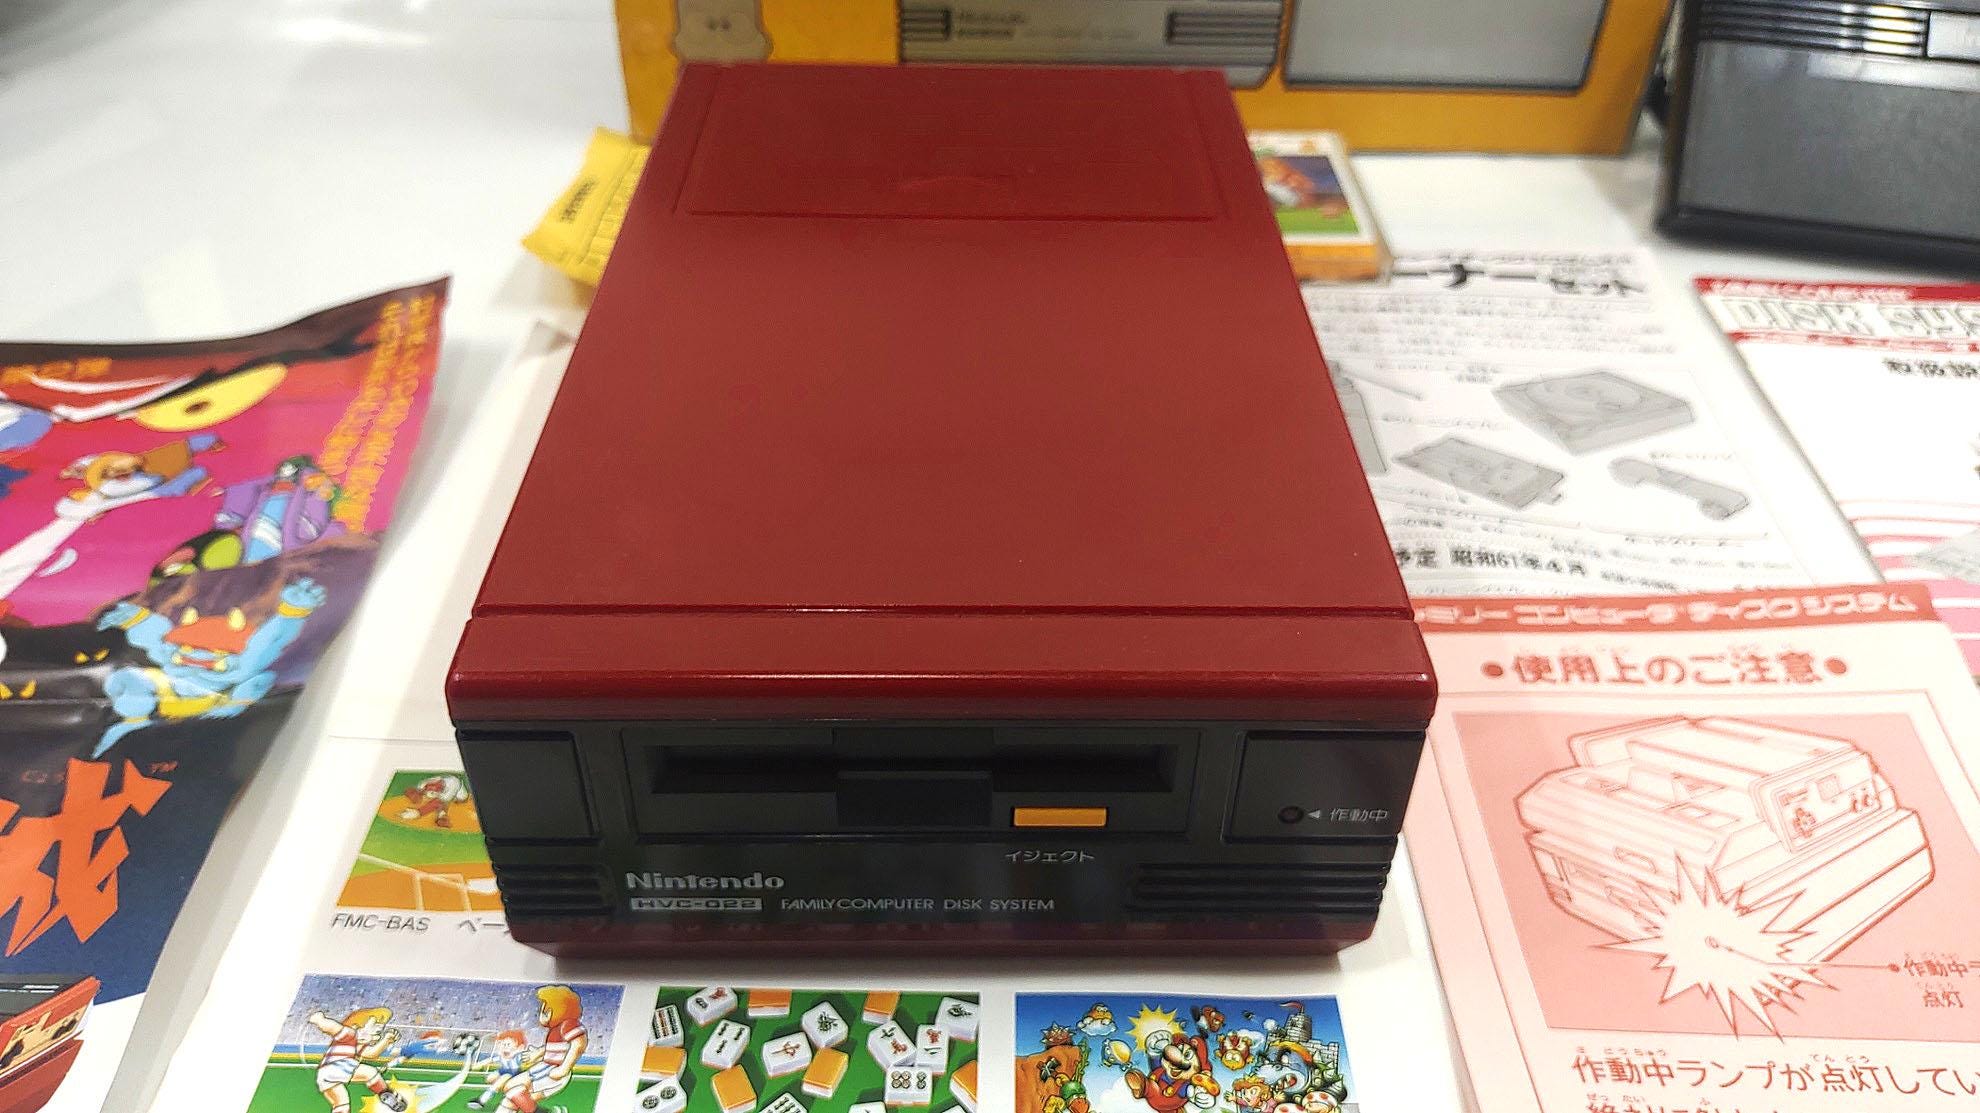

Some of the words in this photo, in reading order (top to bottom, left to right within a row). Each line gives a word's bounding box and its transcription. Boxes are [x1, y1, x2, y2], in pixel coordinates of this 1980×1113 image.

[1513, 652, 1821, 684] 使用上のご注意
[1330, 808, 1388, 822] 作動中
[1005, 850, 1095, 862] イジェクト
[626, 872, 785, 889] Nintendo
[637, 899, 758, 909] HVC-022
[943, 898, 983, 910] DISK
[989, 898, 1055, 910] SYSTEM
[331, 912, 431, 931] FMC-BAS
[458, 917, 510, 934] ベー
[1924, 990, 1963, 1008] 点灯
